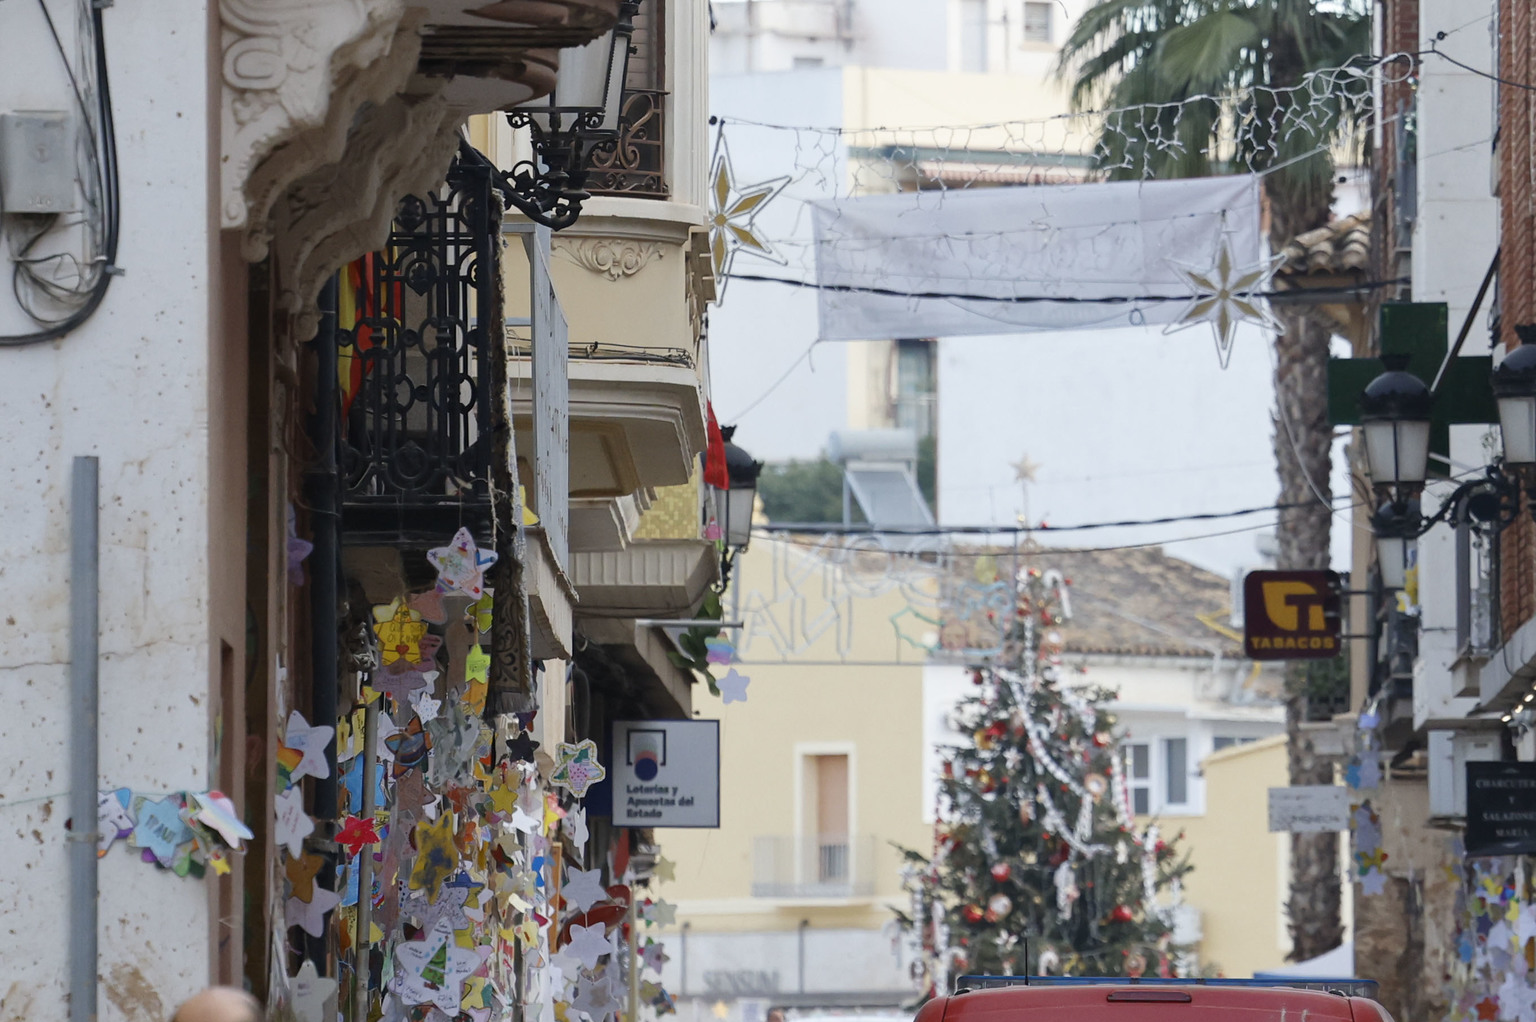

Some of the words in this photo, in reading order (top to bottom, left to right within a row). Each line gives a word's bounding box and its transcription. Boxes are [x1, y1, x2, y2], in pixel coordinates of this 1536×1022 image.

[1251, 637, 1335, 649] TABACOS
[672, 786, 678, 796] y
[627, 797, 676, 807] Apuestas
[678, 796, 694, 806] del
[626, 809, 662, 818] Estado
